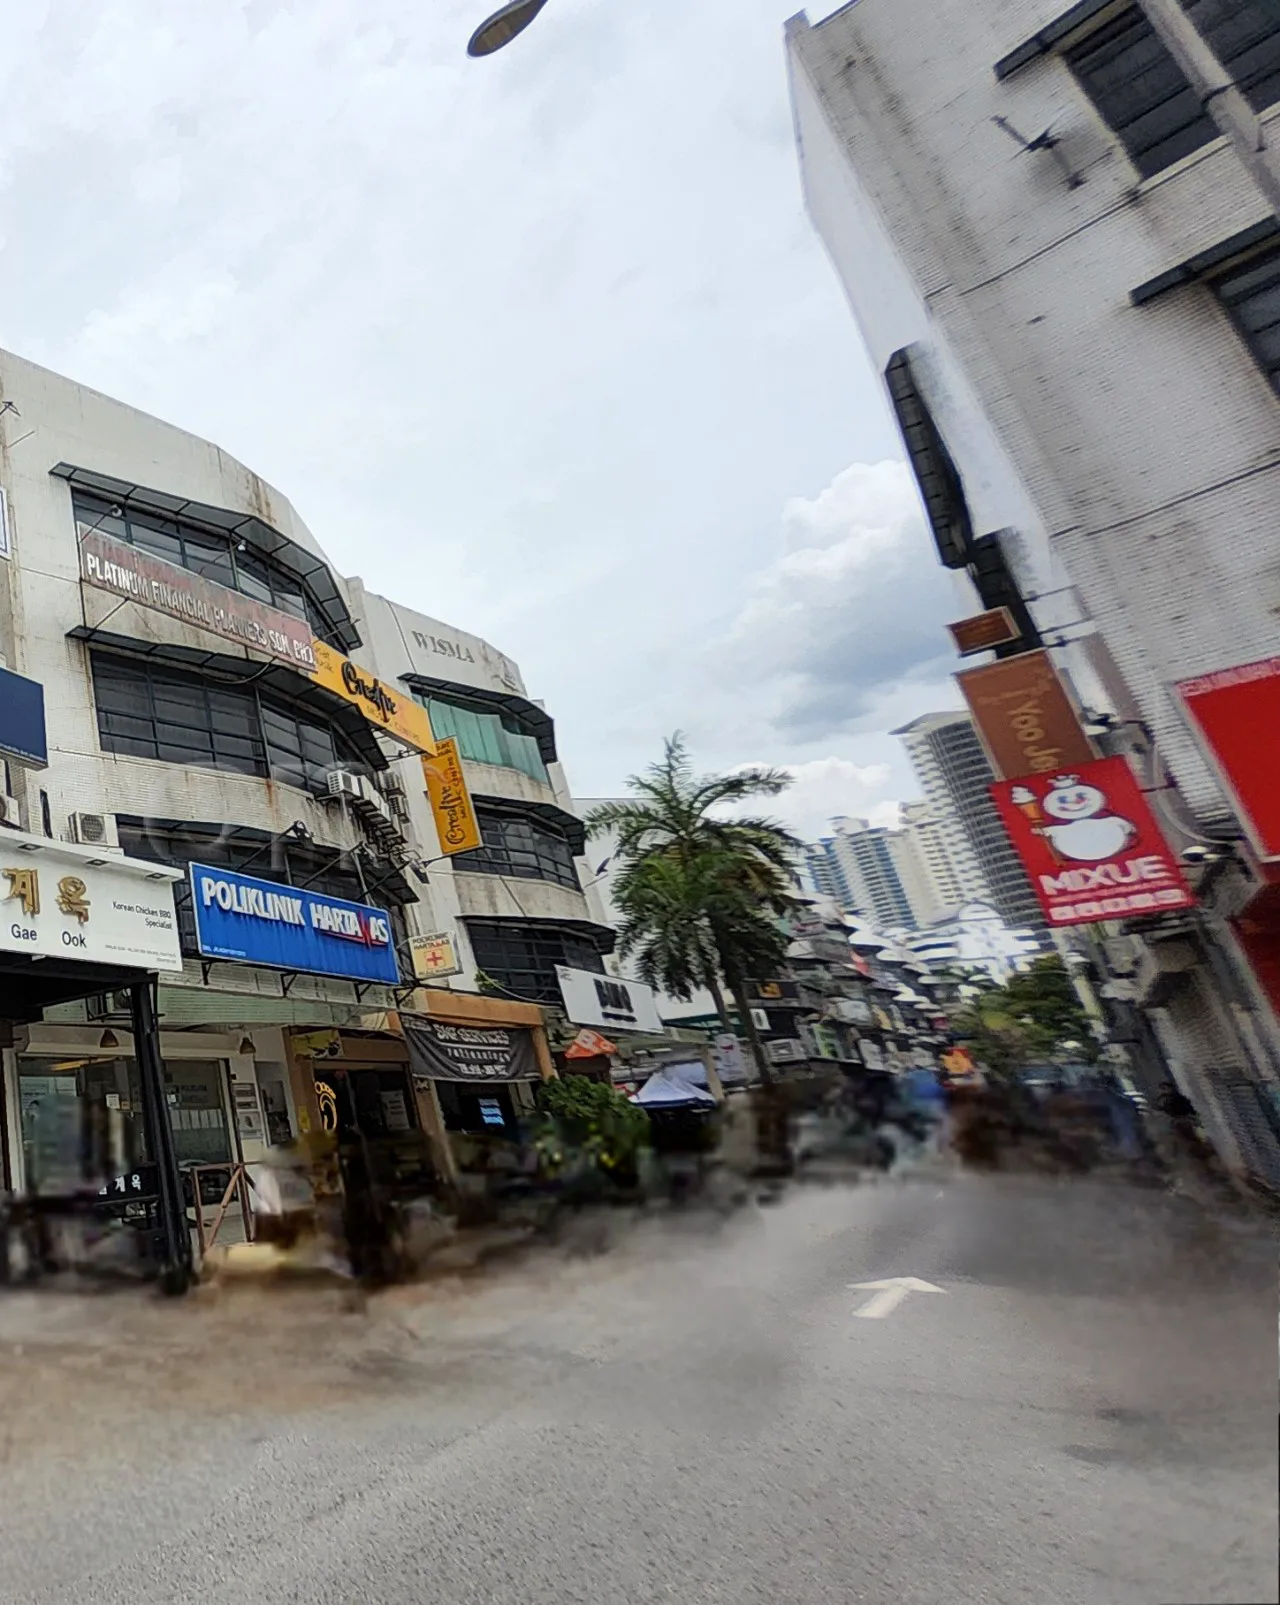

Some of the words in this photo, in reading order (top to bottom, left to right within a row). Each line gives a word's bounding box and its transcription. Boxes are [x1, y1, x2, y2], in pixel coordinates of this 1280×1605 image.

[86, 553, 149, 601] PLATINUM
[411, 630, 475, 664] WISMA
[1038, 854, 1174, 896] MIXUE
[112, 900, 135, 912] Korean
[135, 905, 159, 917] Chicken
[200, 876, 306, 927] POLIKLINIK
[11, 923, 38, 942] Gae
[61, 931, 88, 949] Ook
[144, 917, 173, 930] Specialist
[457, 1028, 510, 1045] SERVICES
